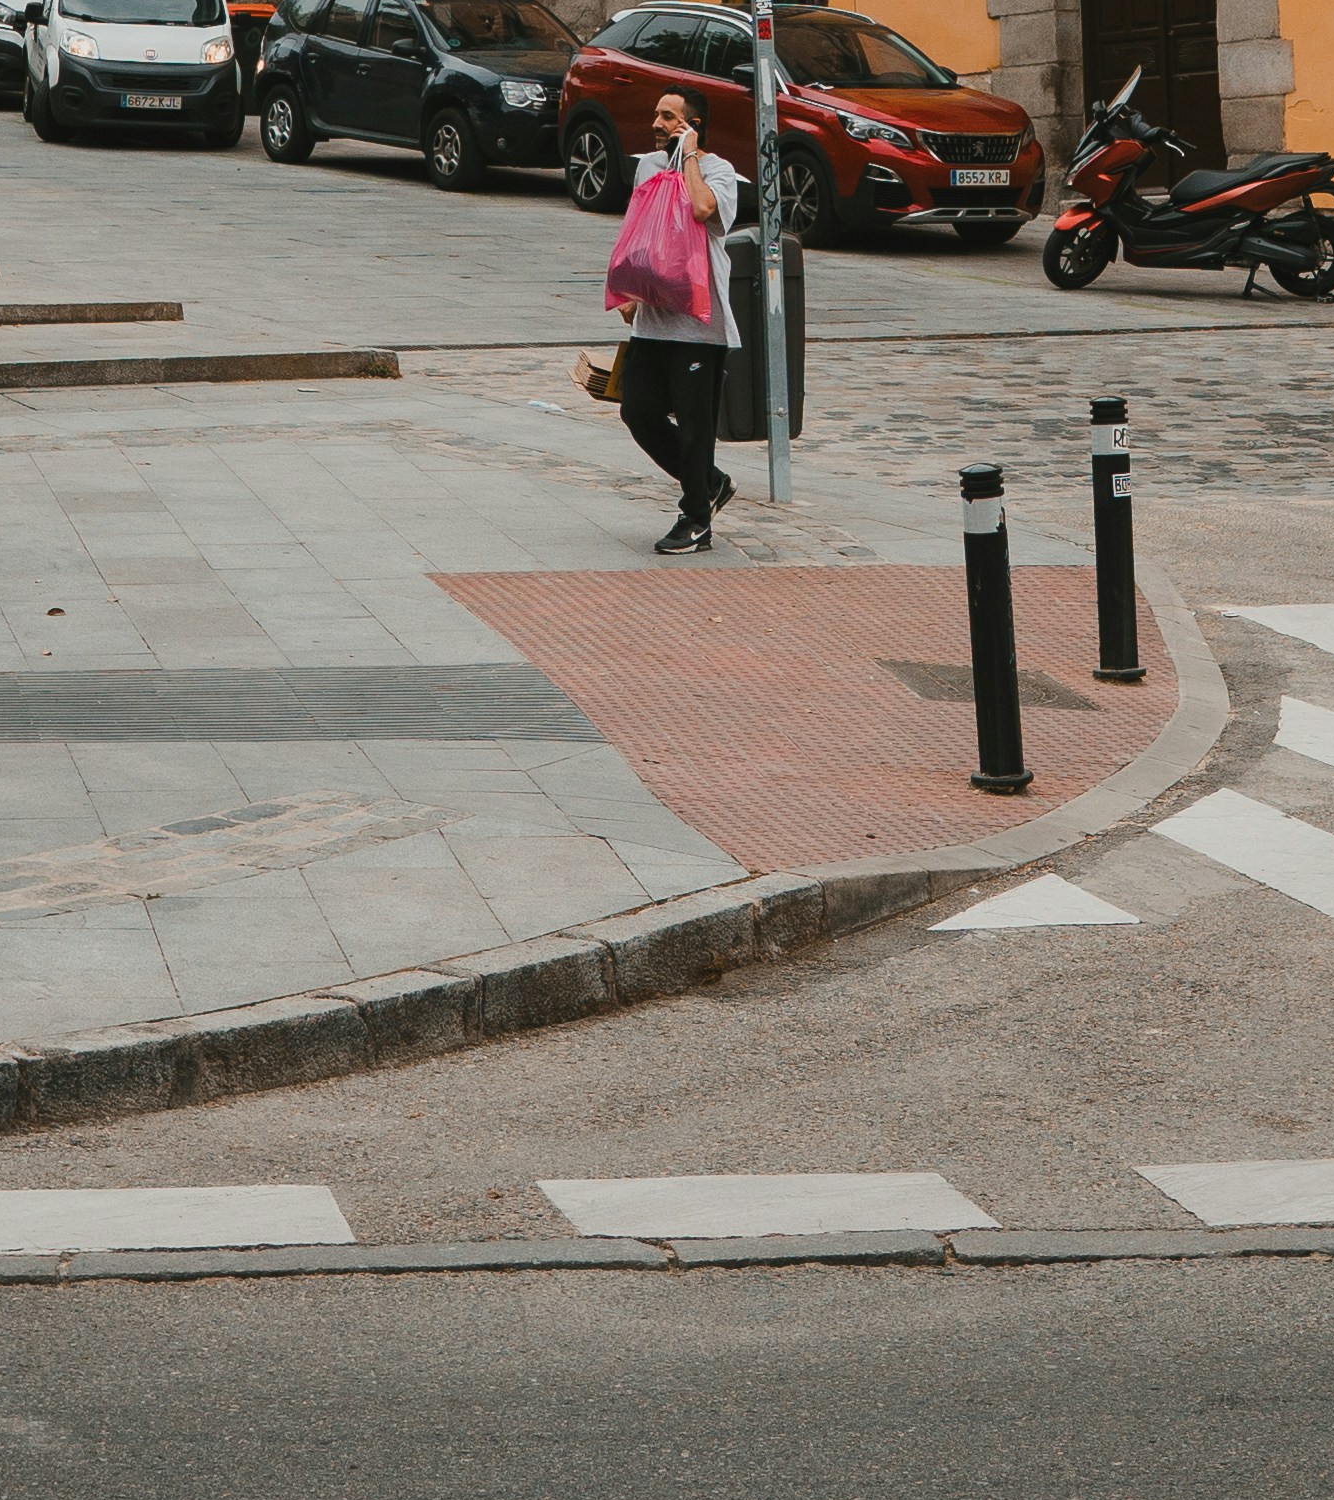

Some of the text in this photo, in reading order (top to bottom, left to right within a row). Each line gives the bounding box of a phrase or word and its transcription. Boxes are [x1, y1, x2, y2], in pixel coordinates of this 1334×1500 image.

[128, 96, 179, 108] 6672 KJL
[958, 171, 1009, 184] 8552 KRJ
